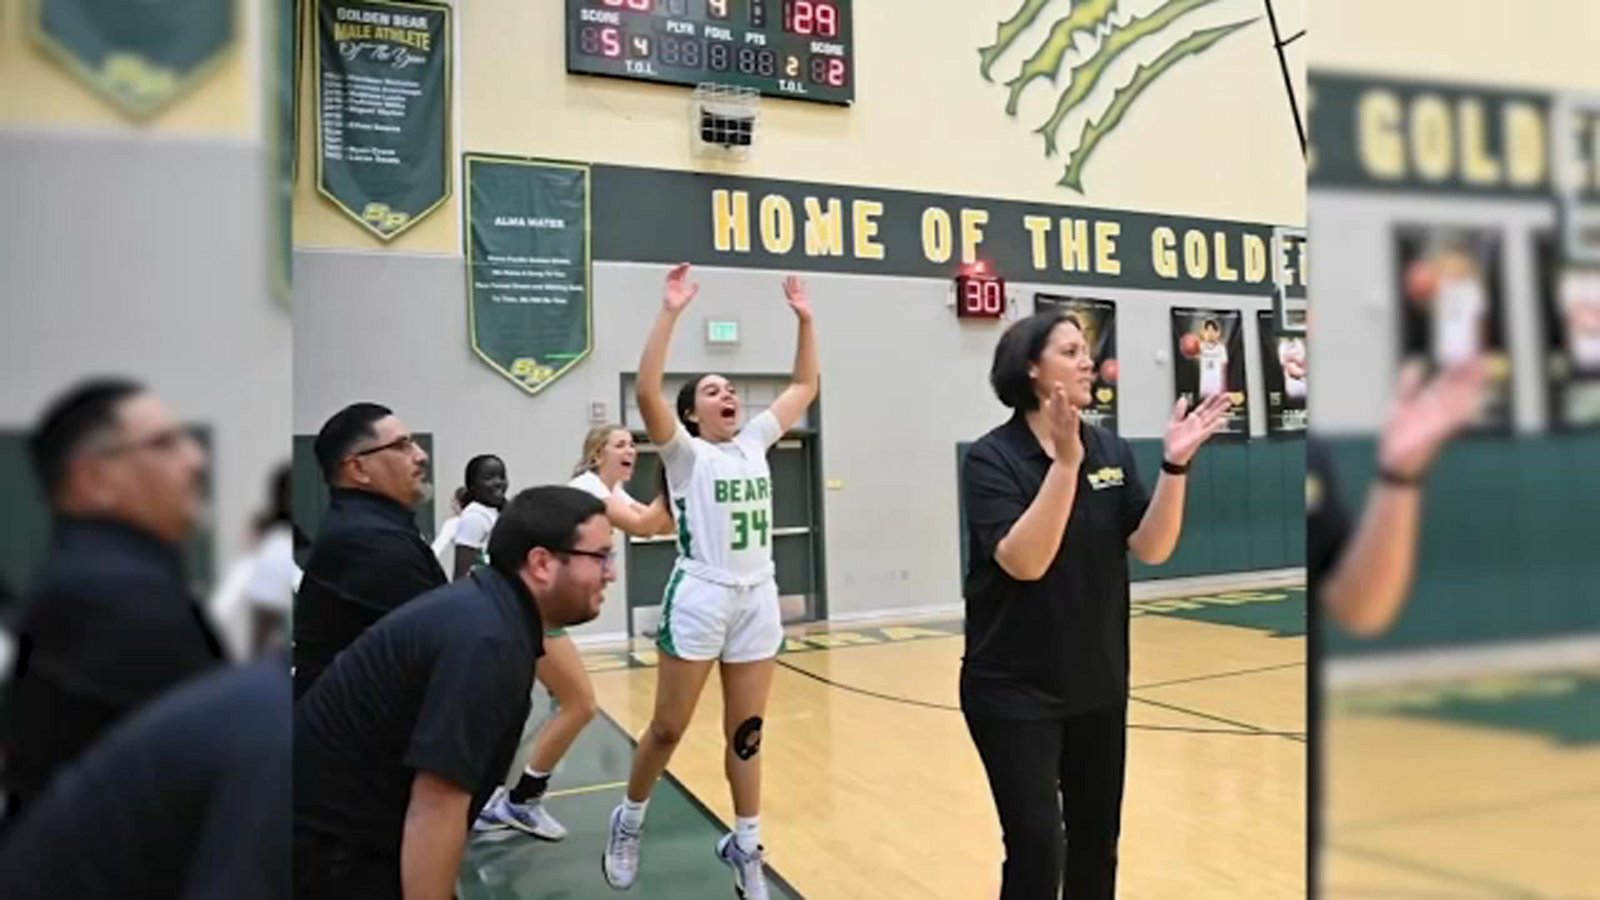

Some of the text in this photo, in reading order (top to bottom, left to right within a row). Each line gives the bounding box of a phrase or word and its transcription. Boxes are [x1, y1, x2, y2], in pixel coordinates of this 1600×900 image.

[337, 7, 428, 29] GOLDEN BEAR
[580, 9, 620, 25] SCORE
[793, 1, 836, 36] 29
[335, 22, 430, 51] MALE ATHLETE
[601, 28, 620, 57] 5
[633, 37, 648, 56] 4
[744, 32, 766, 46] PTS
[810, 41, 844, 56] SCORE
[785, 56, 799, 77] 2
[828, 59, 845, 86] 2
[494, 216, 566, 229] ALMA MATER
[712, 189, 885, 260] HOME
[921, 207, 989, 264] OF
[1023, 215, 1121, 276] THE
[966, 280, 1001, 313] 30
[714, 476, 771, 503] BEAR
[730, 509, 769, 551] 34
